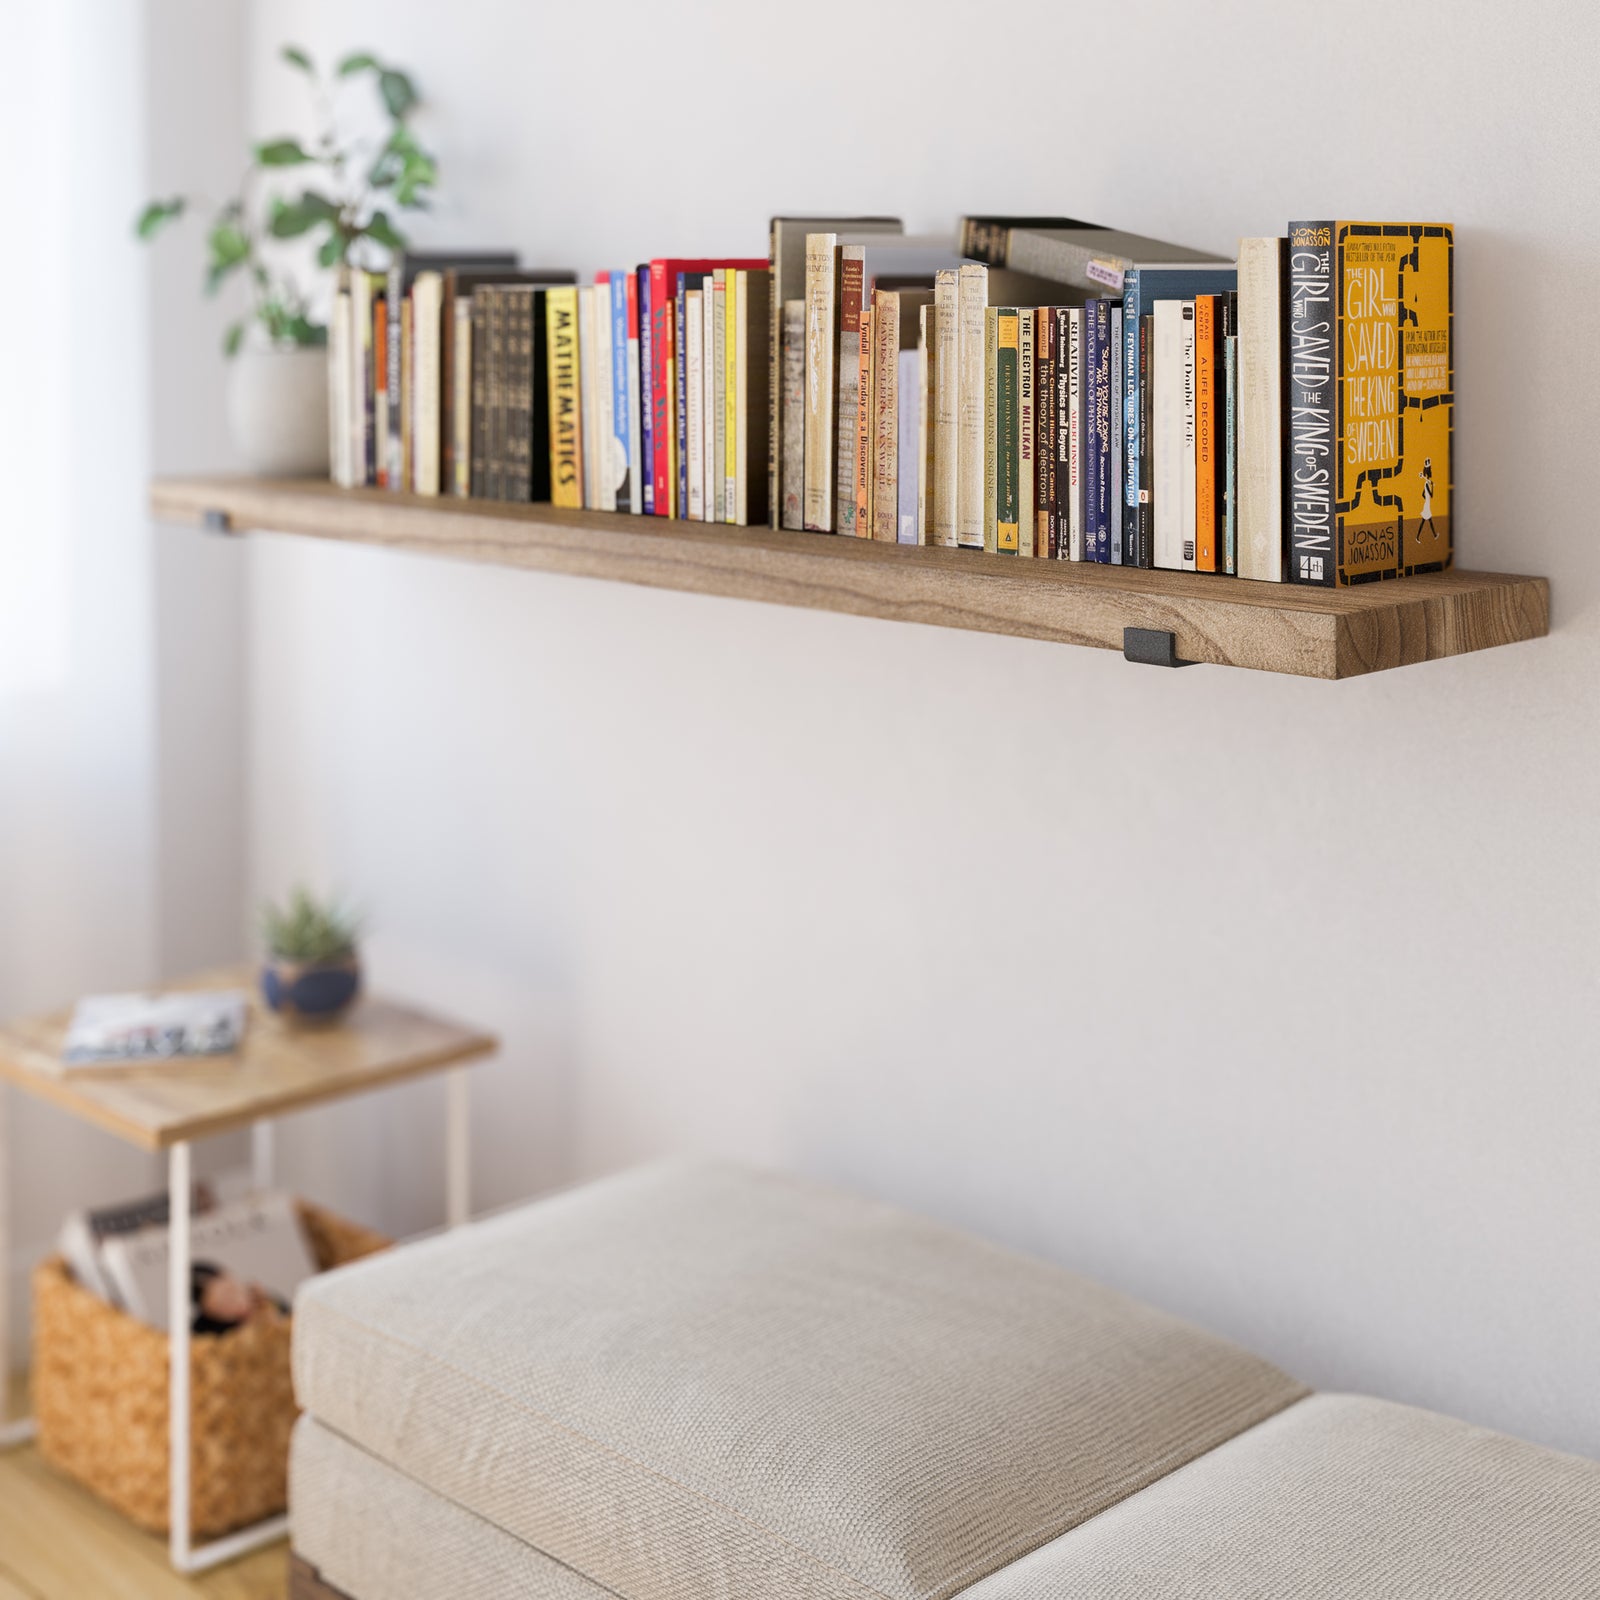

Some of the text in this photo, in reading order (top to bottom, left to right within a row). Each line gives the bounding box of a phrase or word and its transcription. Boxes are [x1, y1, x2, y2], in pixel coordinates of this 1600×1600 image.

[1291, 228, 1331, 236] JONAS
[1291, 236, 1331, 247] JONASSON
[1346, 268, 1396, 319] THE GIRL WHO
[716, 303, 724, 383] Indiscrete
[860, 322, 870, 354] Tyndall
[1184, 334, 1192, 360] The
[1347, 321, 1396, 373] SAVED
[1201, 357, 1208, 365] A
[556, 310, 576, 486] MATHEMATICS
[860, 369, 869, 407] Faraday
[1022, 316, 1031, 460] THE ELECTRON MILLIKAN
[1088, 389, 1095, 404] OF
[1114, 385, 1120, 394] OF
[1184, 364, 1192, 410] Double
[1291, 252, 1331, 551] THE GIRL WHO SAVED THE KING OF SWEDEN
[1347, 376, 1395, 417] THE KING
[860, 411, 866, 422] as
[1038, 390, 1048, 428] theory
[1058, 373, 1068, 462] Physics and Beyond
[1040, 432, 1048, 445] of
[1127, 427, 1134, 440] ON
[1347, 418, 1395, 464] OF SWEDEN
[860, 436, 868, 489] Discoverer
[1049, 452, 1054, 461] of
[1040, 448, 1048, 504] electrons
[1348, 526, 1394, 546] JONAS
[1348, 542, 1394, 566] JONASSON
